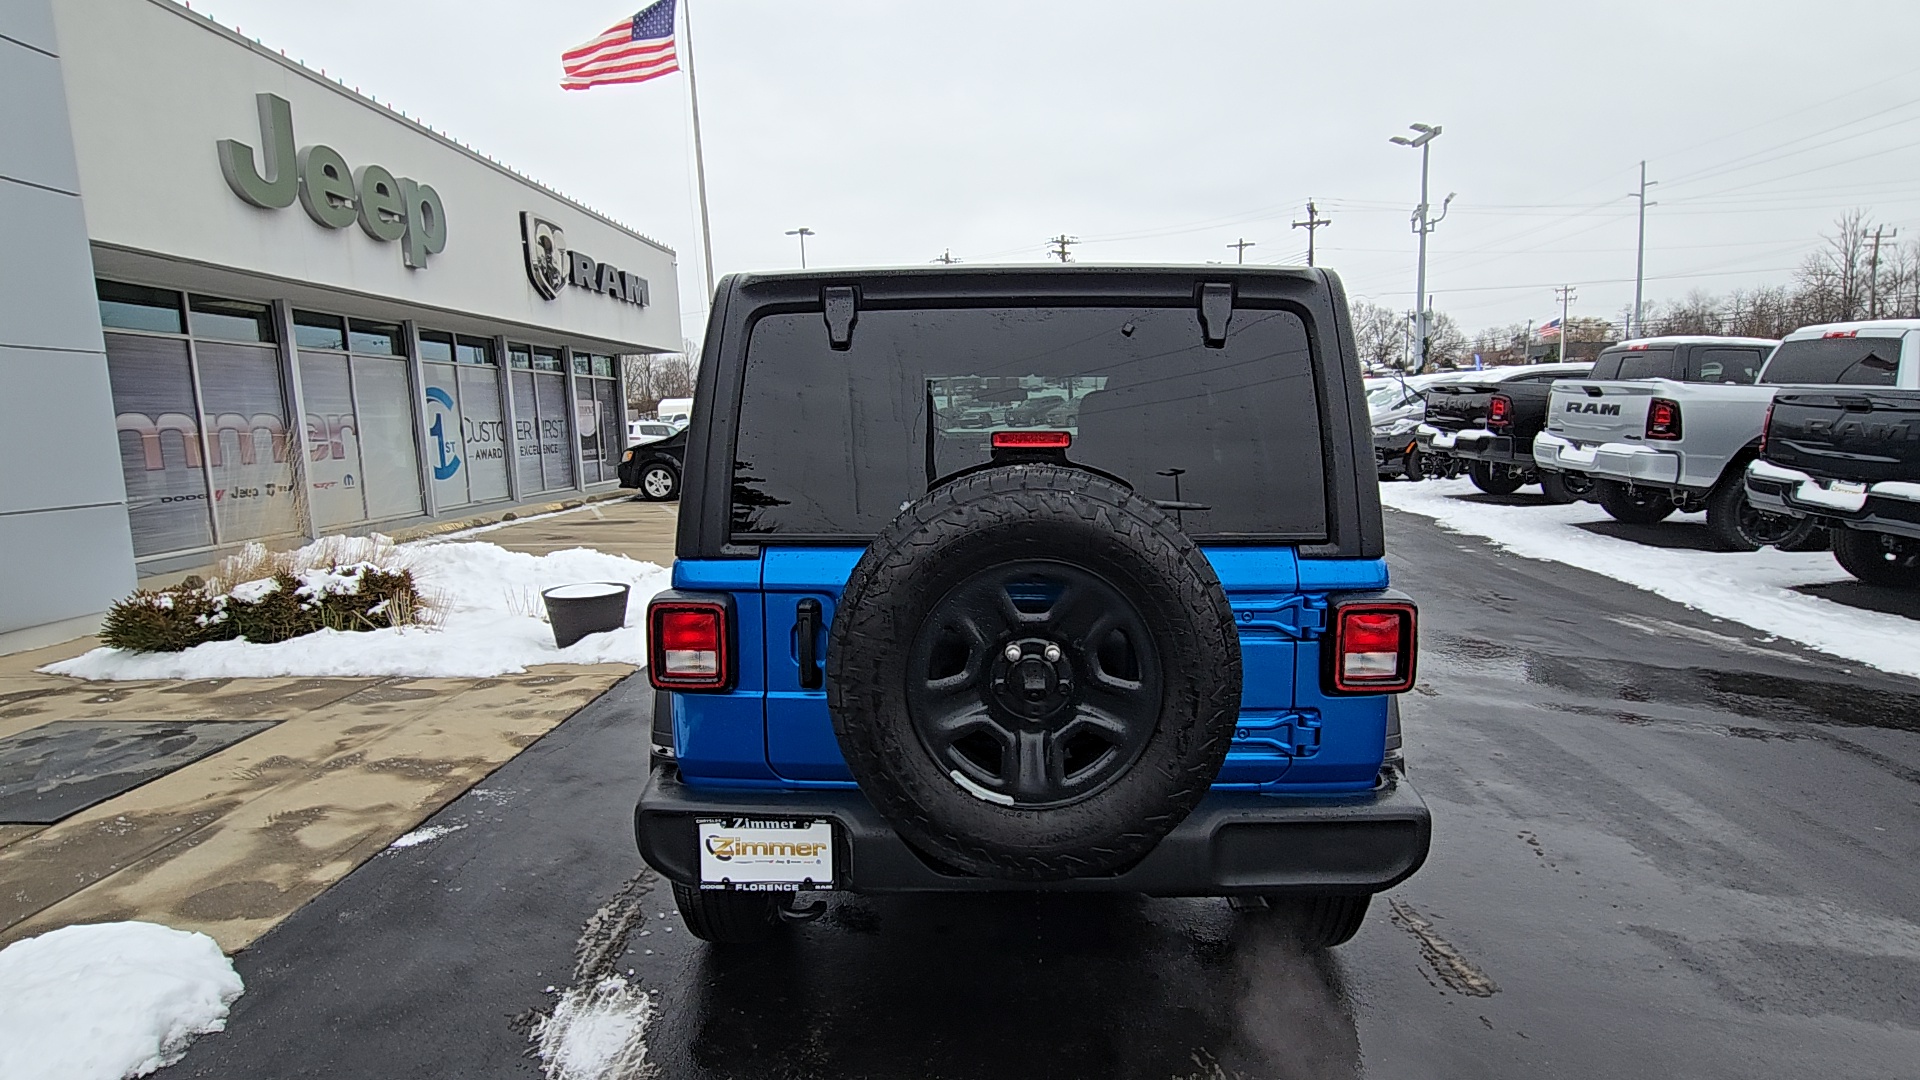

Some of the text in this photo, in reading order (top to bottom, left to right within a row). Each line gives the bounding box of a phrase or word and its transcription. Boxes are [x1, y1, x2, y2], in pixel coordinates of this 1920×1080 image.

[217, 92, 447, 270] Jeep
[566, 249, 650, 307] RAM
[1566, 402, 1621, 416] RAM
[461, 416, 533, 444] CUSTOER
[1803, 418, 1911, 440] RAM
[475, 443, 559, 461] AWARD EXCELENCE
[733, 817, 796, 829] Zimmer
[713, 836, 827, 857] Zimmer
[735, 883, 800, 892] FLORENCE
